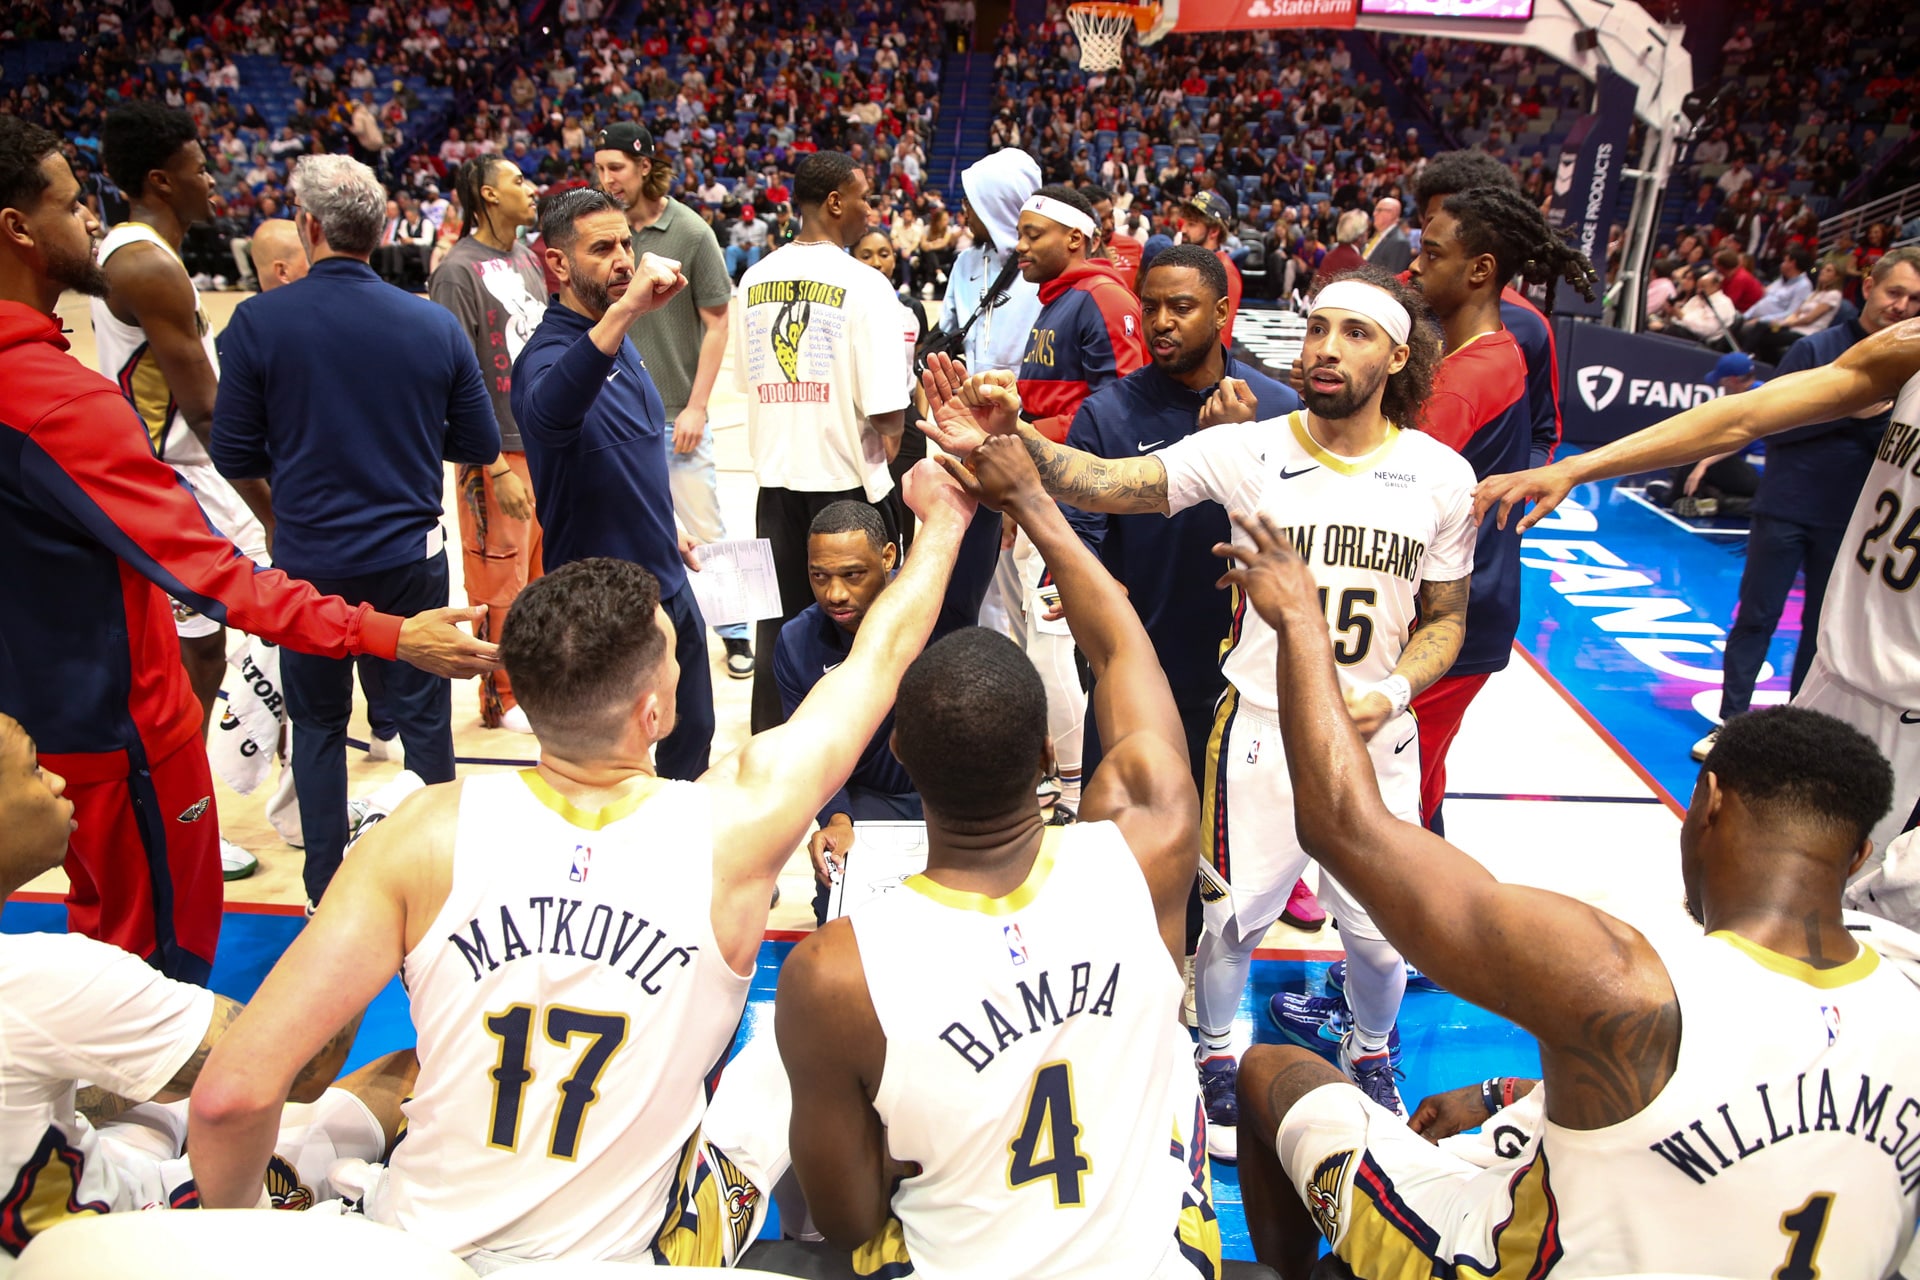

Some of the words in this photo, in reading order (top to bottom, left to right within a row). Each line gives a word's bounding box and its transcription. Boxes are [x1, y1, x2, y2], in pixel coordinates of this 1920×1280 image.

[1585, 143, 1613, 221] PRODUCTS
[748, 280, 795, 308] ROLLING
[798, 280, 844, 308] STONES
[486, 309, 513, 393] FROM
[1628, 378, 1726, 409] FAND
[1374, 471, 1417, 483] NEWAGE
[1322, 523, 1426, 584] ORLEANS
[1856, 487, 1920, 593] 25
[448, 896, 700, 996] MATKOVIĆ
[938, 961, 1121, 1074] BAMBA
[482, 1001, 632, 1164] 17
[1005, 1058, 1094, 1210] 4
[1770, 1189, 1838, 1280] 1
